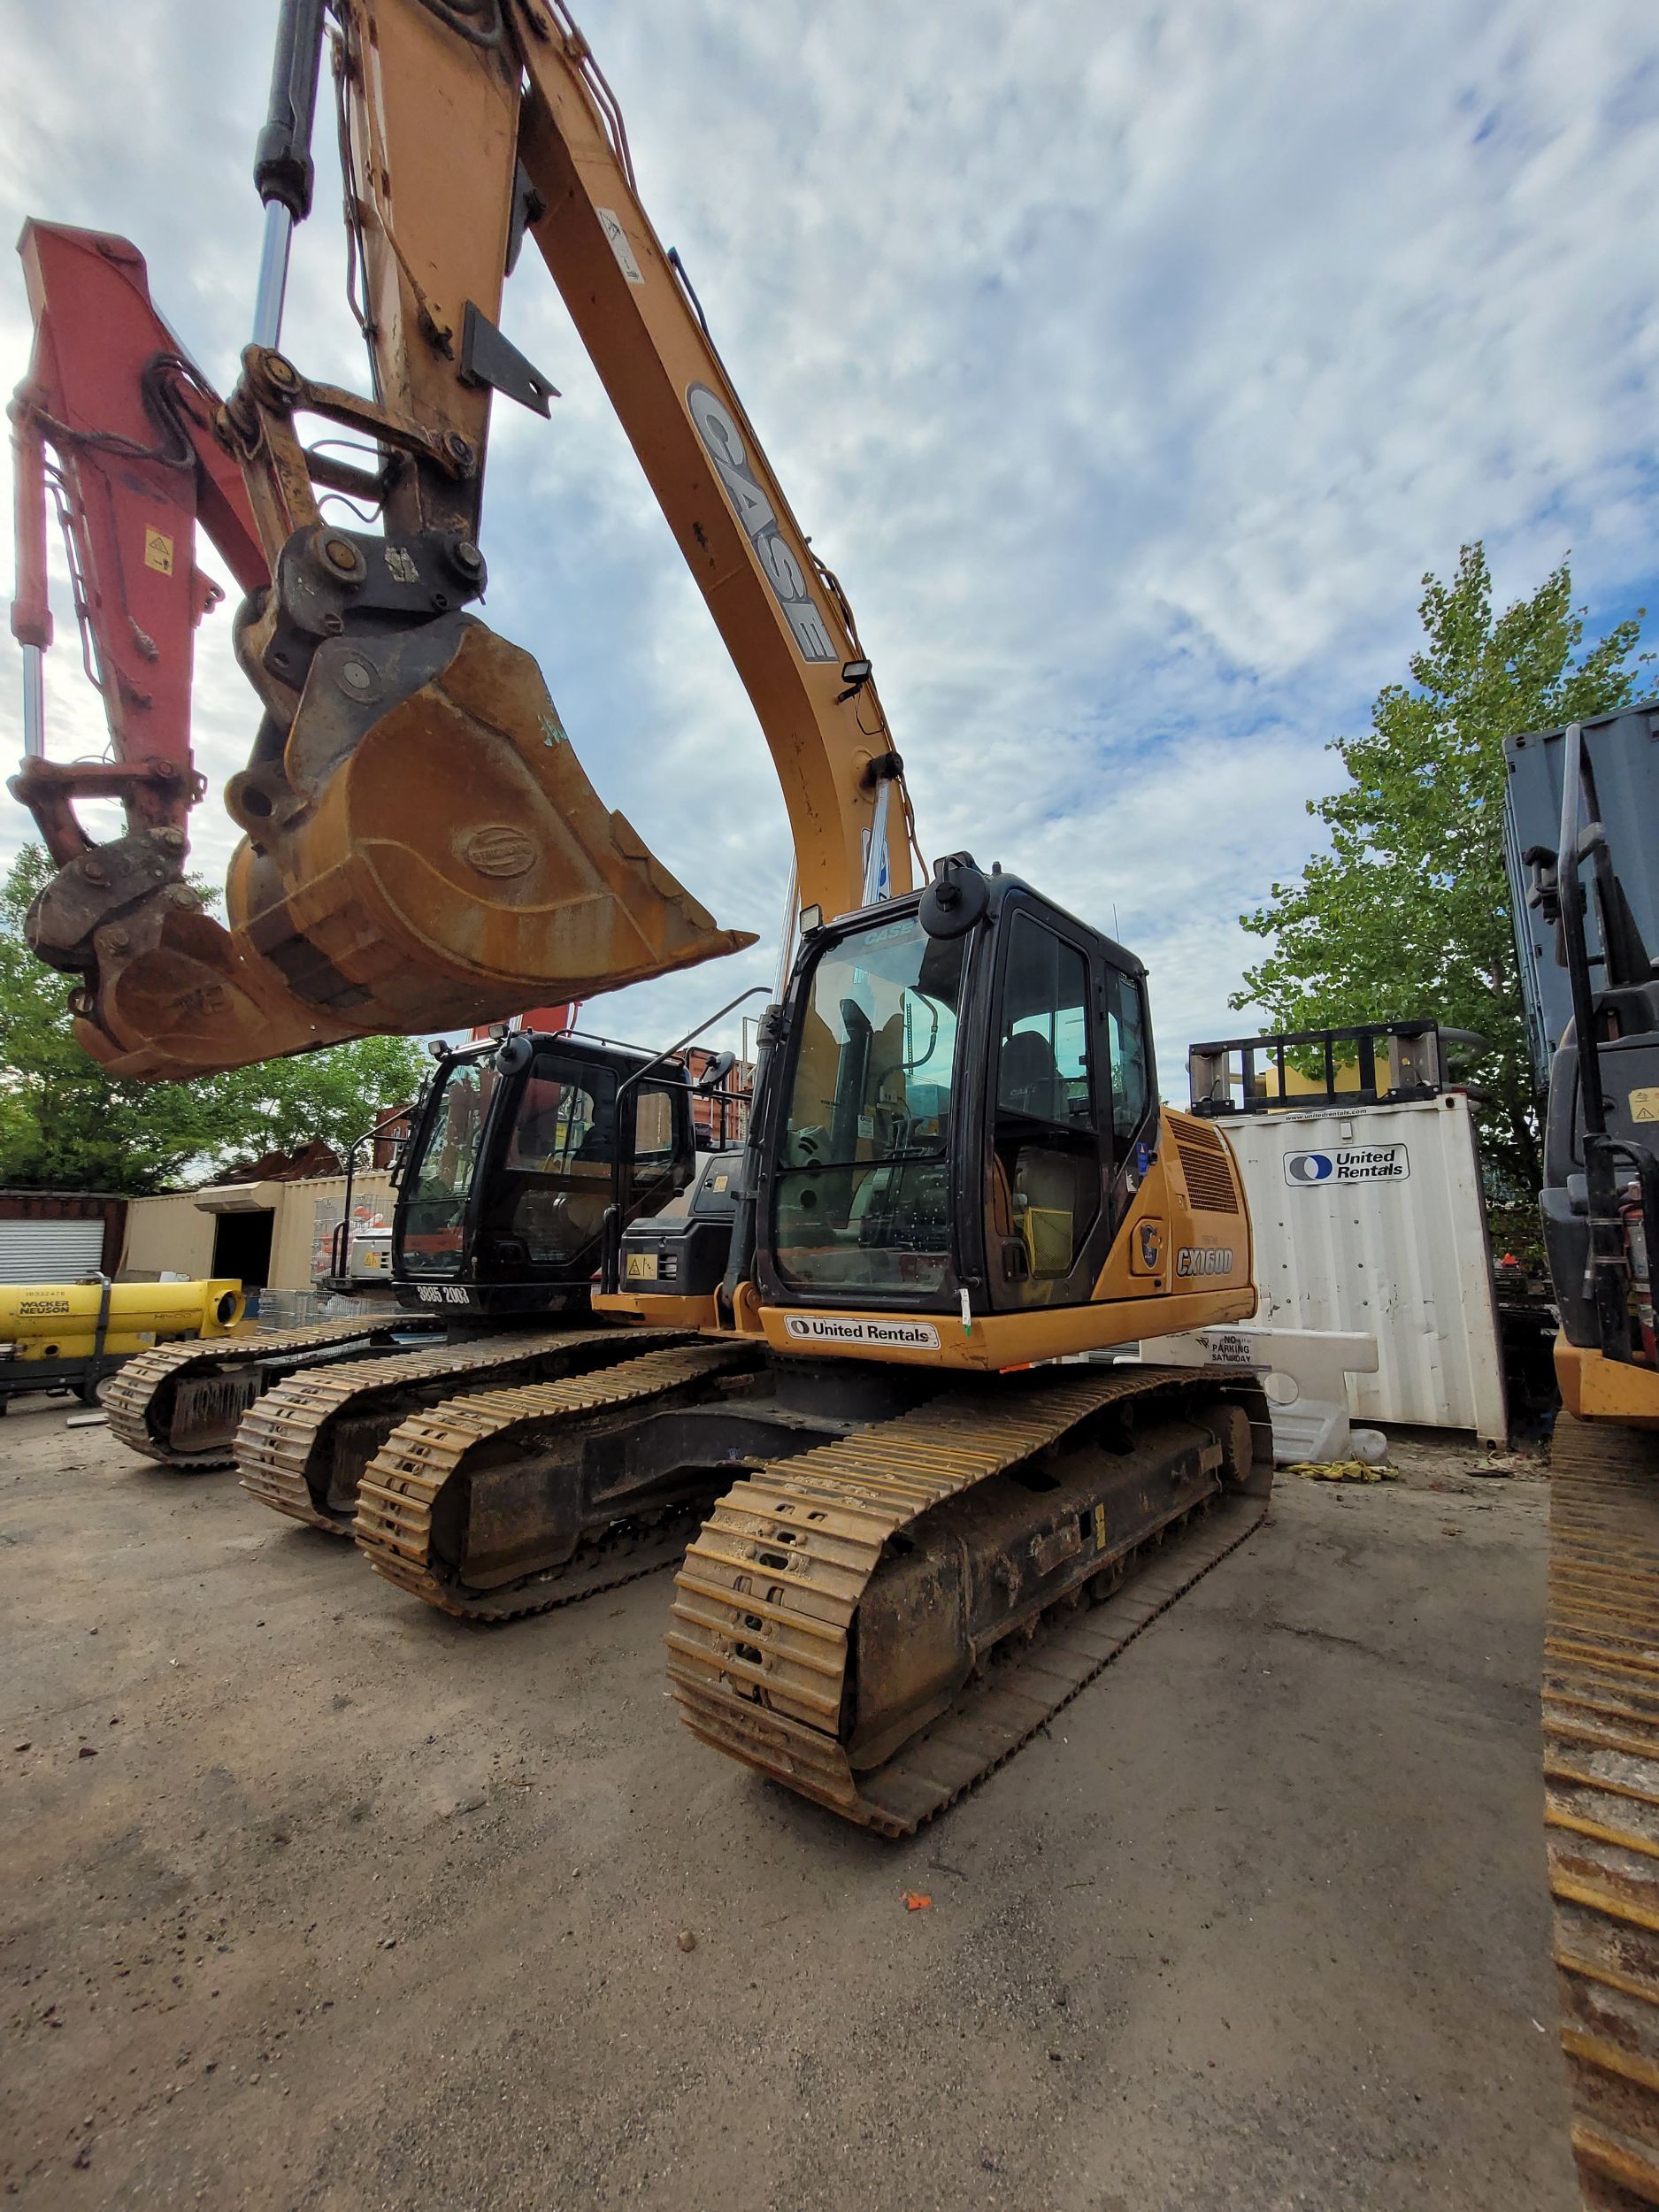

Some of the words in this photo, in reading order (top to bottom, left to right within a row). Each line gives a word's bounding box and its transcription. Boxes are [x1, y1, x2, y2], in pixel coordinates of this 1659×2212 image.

[686, 381, 840, 663] CASE
[1286, 1109, 1367, 1120] www.unitedrentals.com
[1337, 1149, 1395, 1165] United
[1337, 1163, 1403, 1179] Rentals
[1176, 1247, 1233, 1277] CX160D
[813, 1322, 863, 1338] United
[867, 1325, 929, 1343] Rentals
[1224, 1335, 1236, 1344] NO
[1212, 1344, 1249, 1354] PARKING
